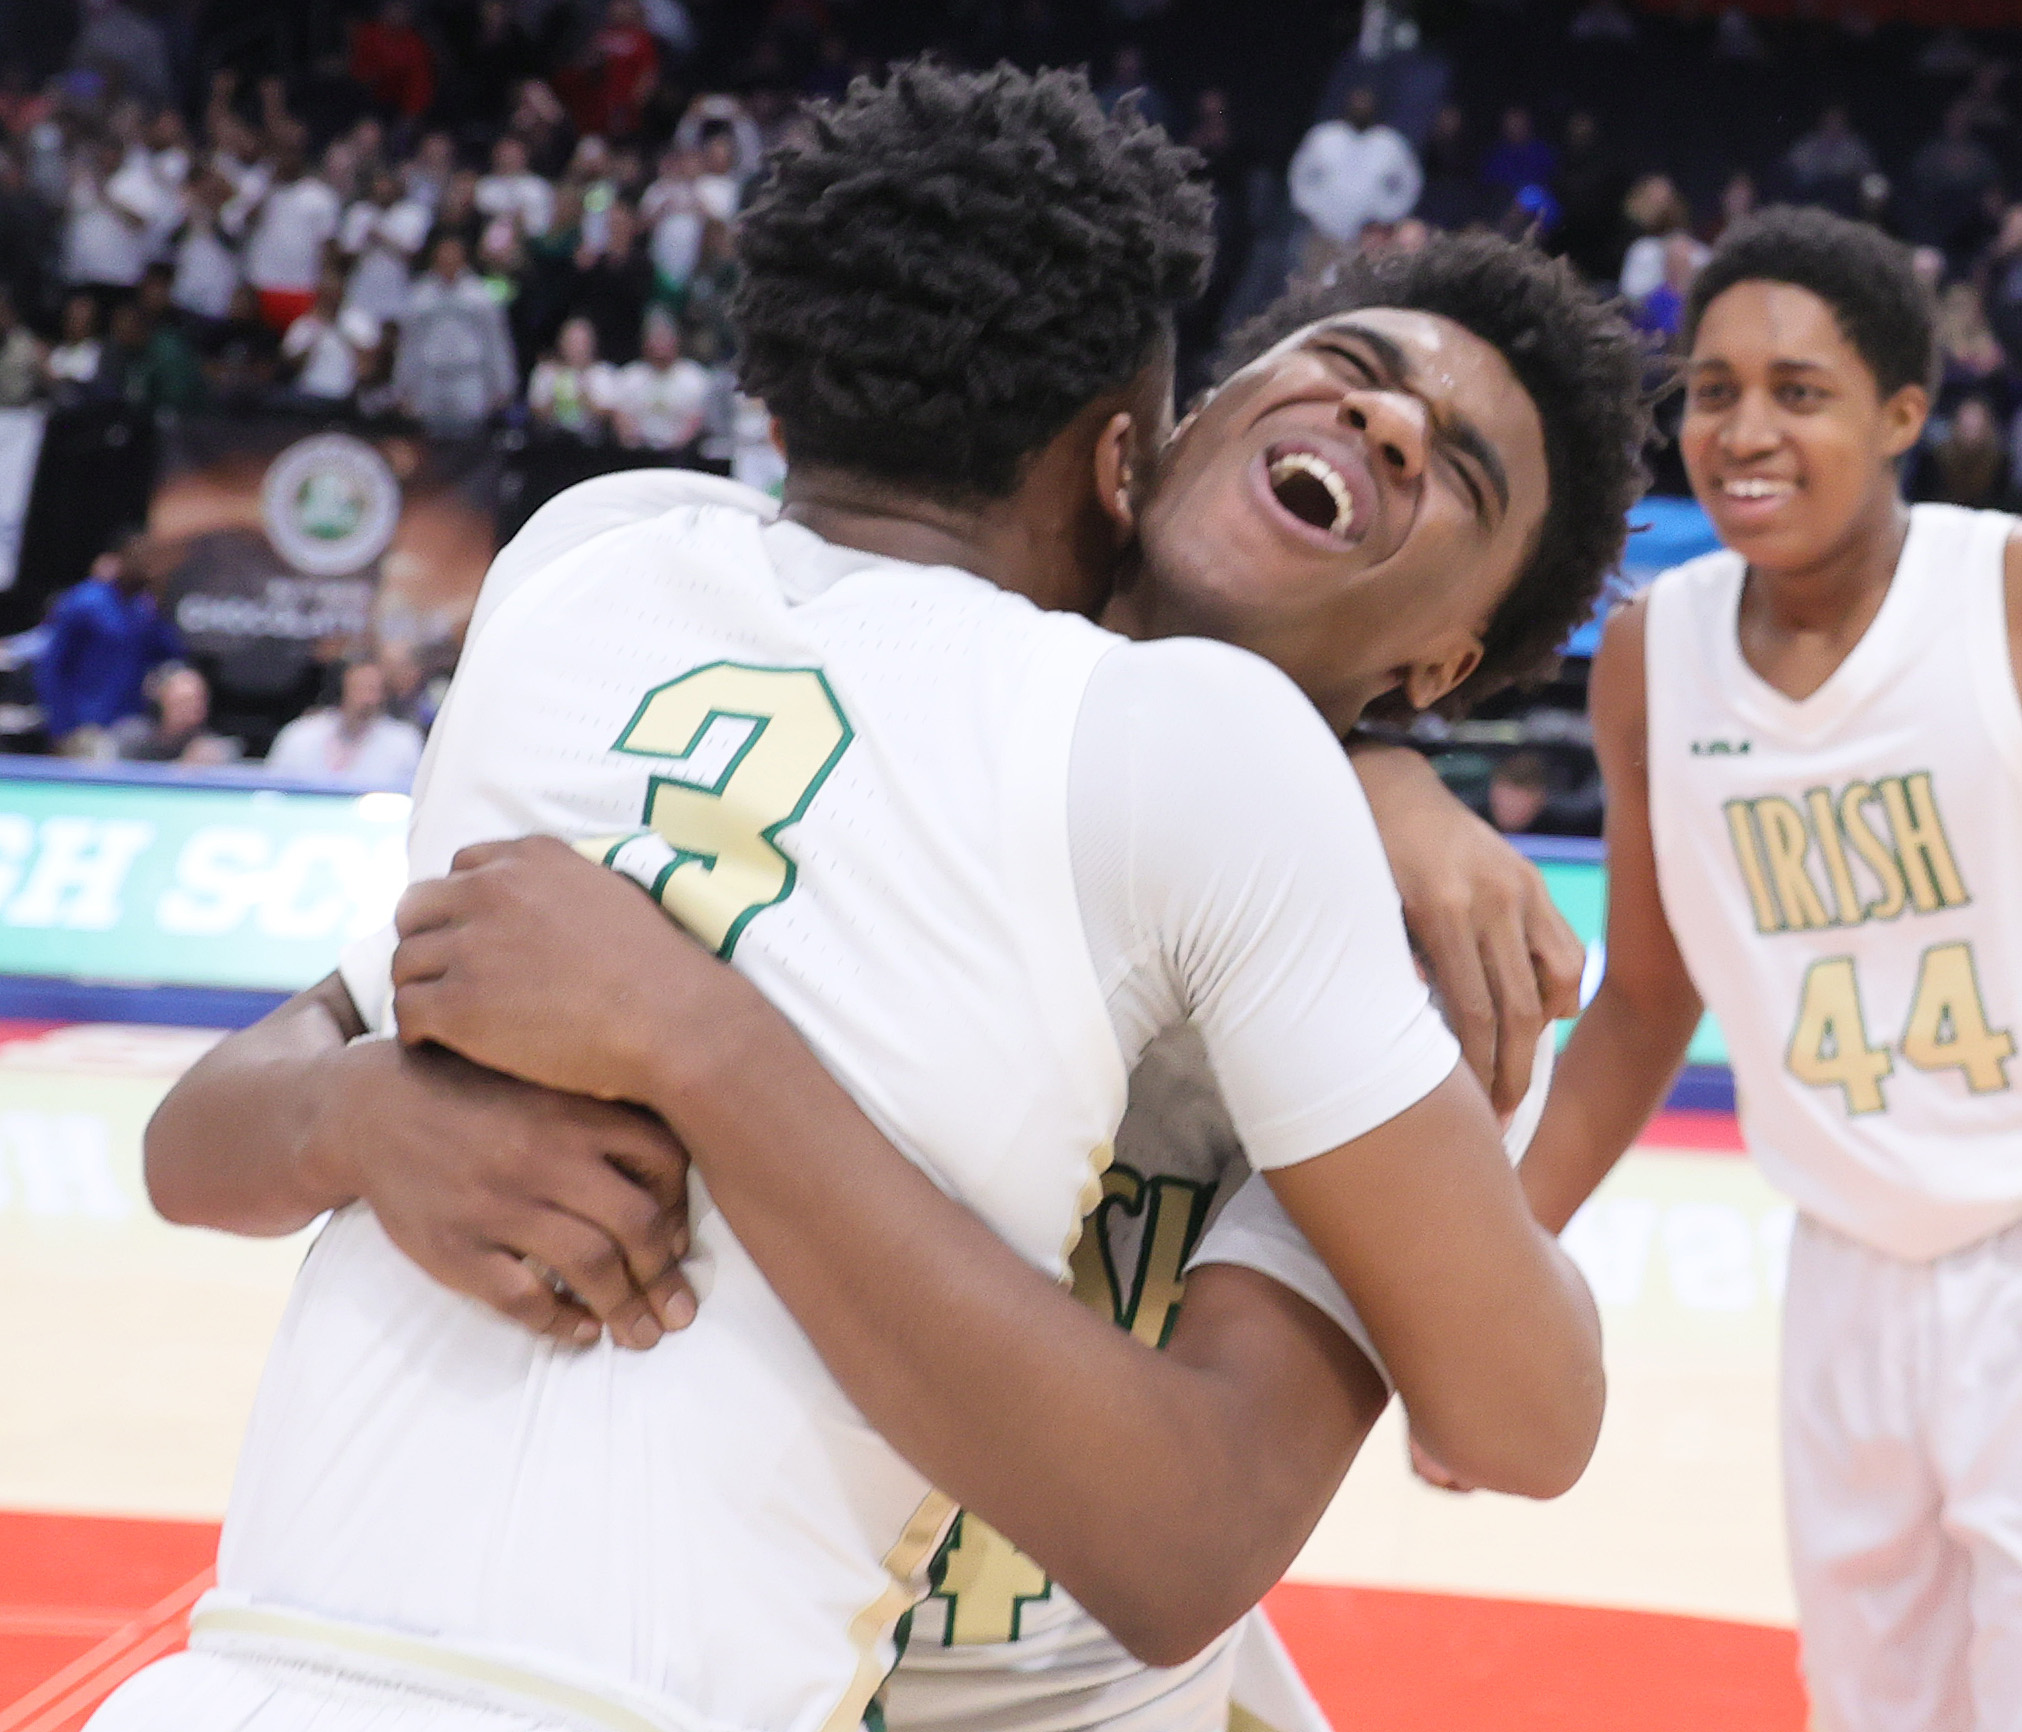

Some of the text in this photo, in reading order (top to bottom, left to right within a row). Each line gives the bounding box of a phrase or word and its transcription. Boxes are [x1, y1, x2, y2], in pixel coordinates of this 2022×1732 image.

[570, 659, 855, 963] 3
[1721, 769, 1972, 936] IRISH
[1783, 939, 2018, 1118] 44
